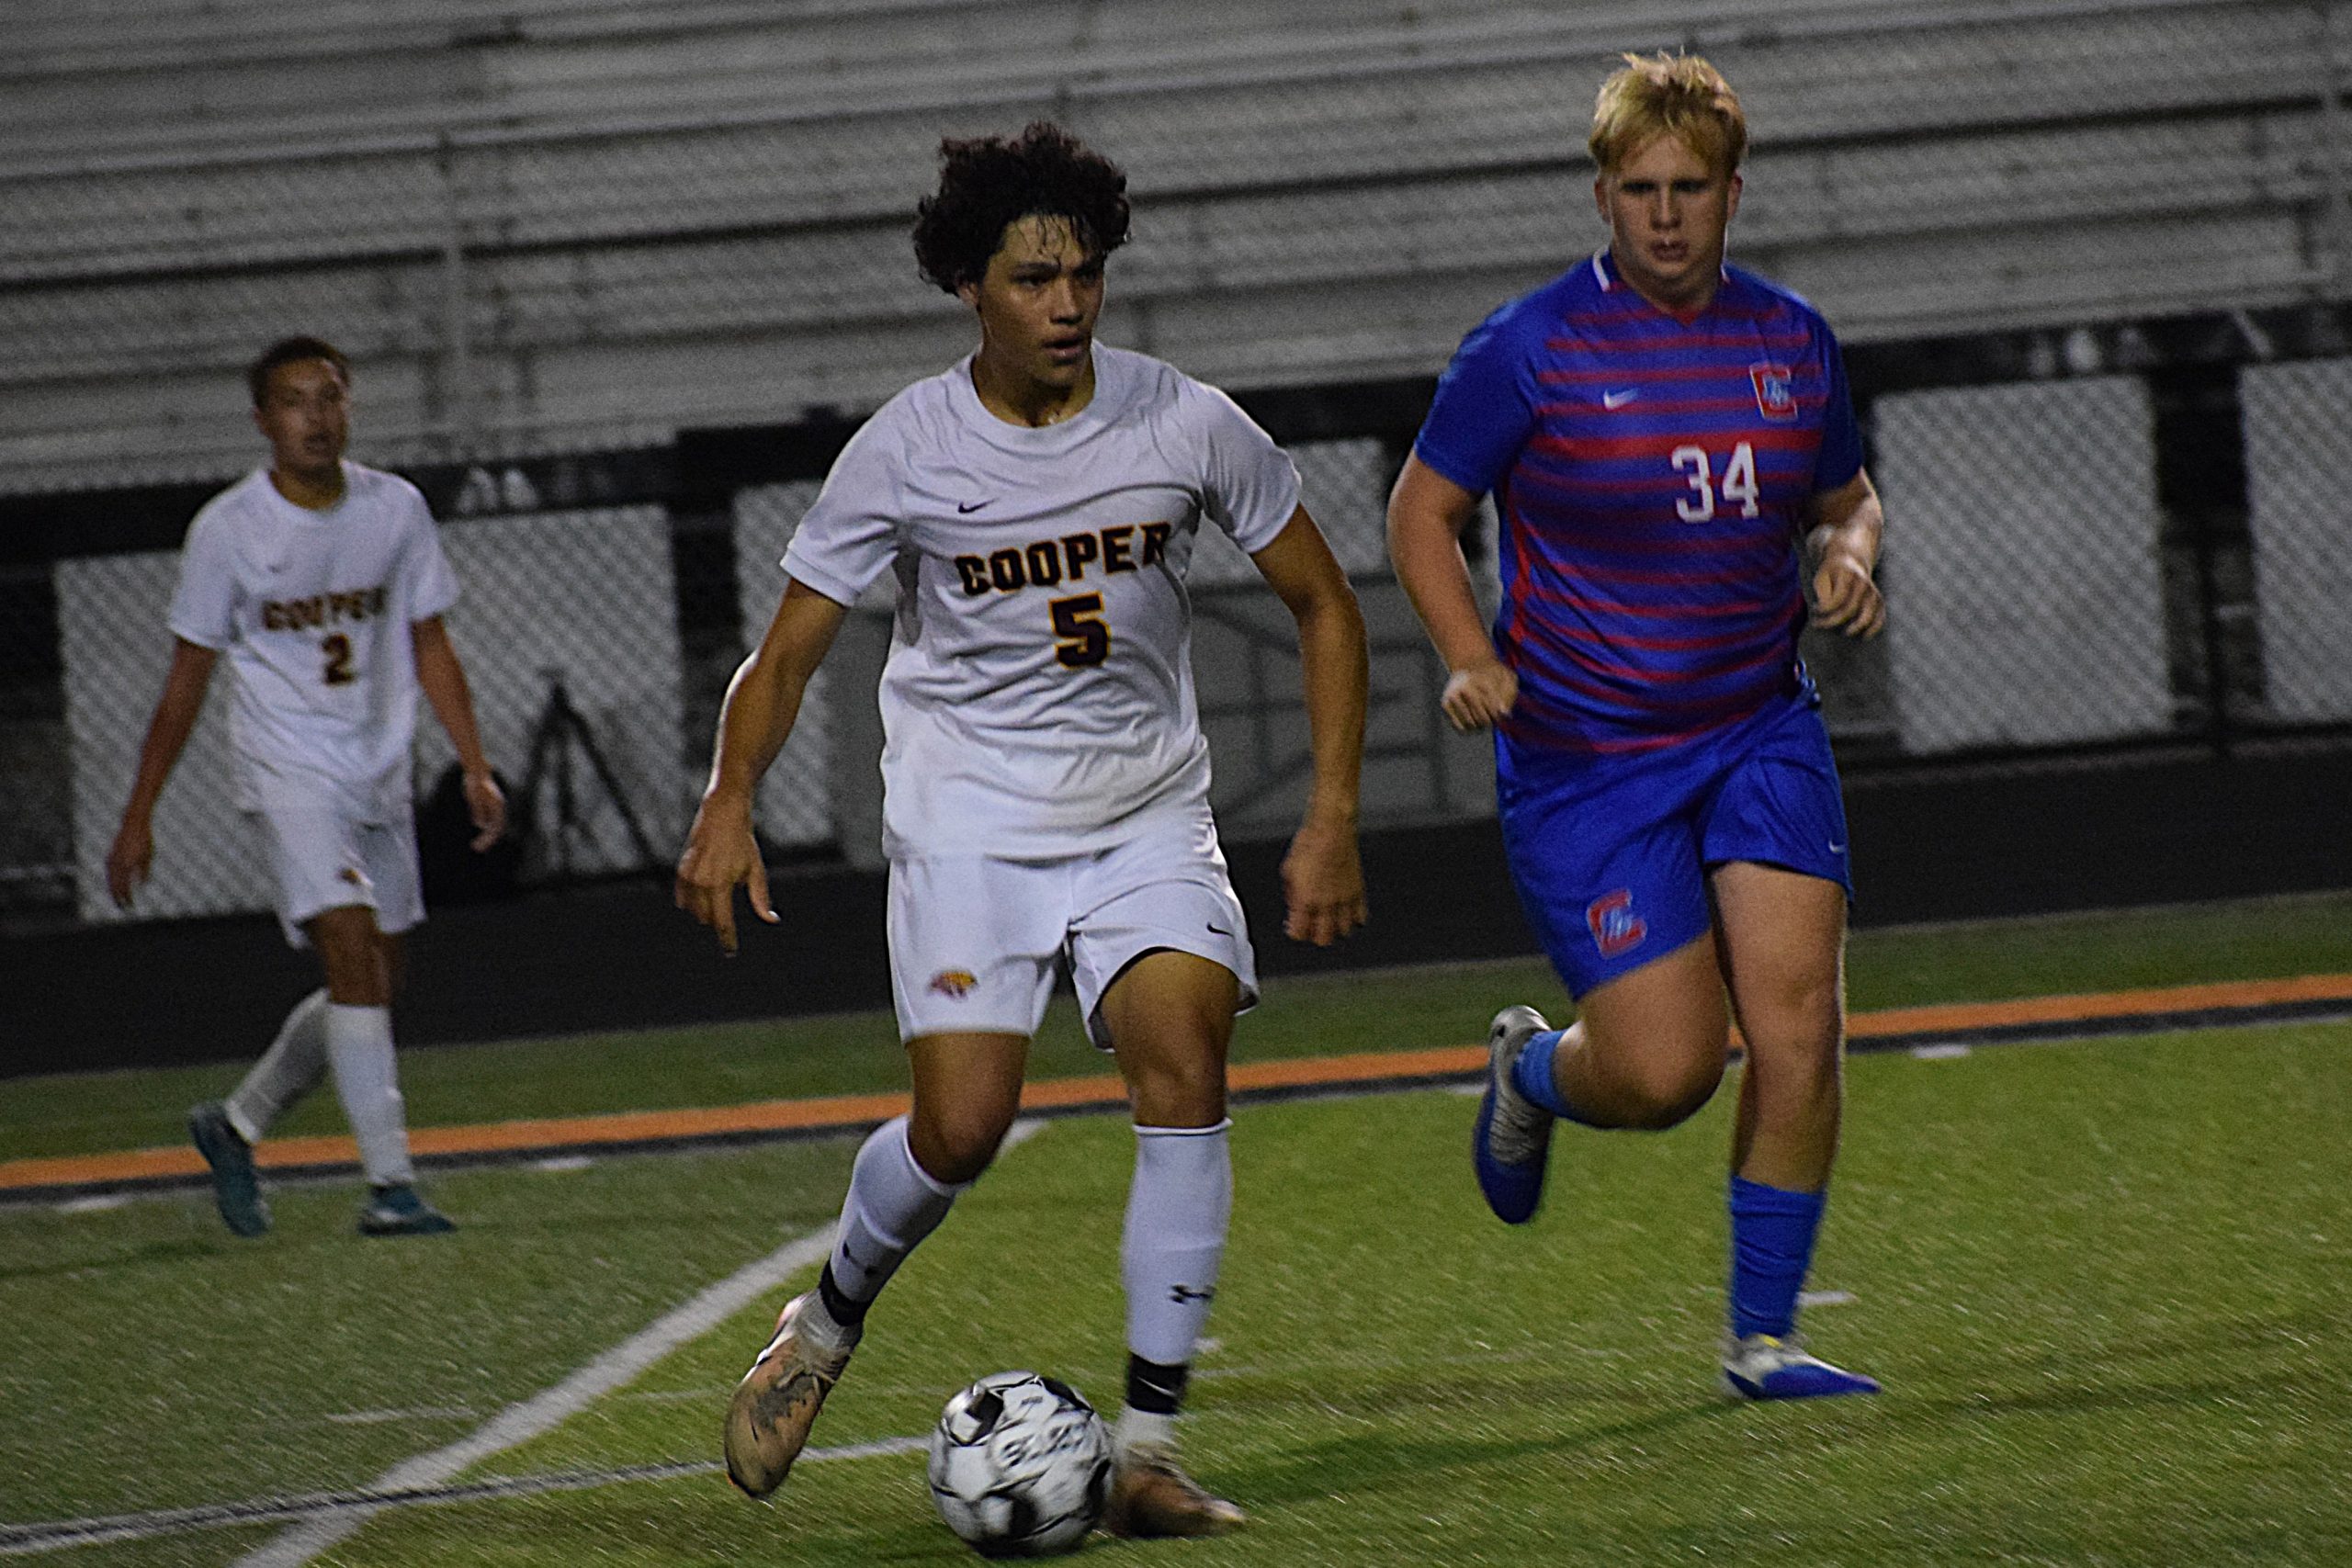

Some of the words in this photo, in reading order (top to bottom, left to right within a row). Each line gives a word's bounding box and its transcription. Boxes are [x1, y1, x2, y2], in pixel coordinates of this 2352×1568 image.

[1670, 440, 1760, 525] 34
[954, 521, 1172, 596] COOPER
[321, 632, 357, 686] 2
[1047, 591, 1113, 671] 5
